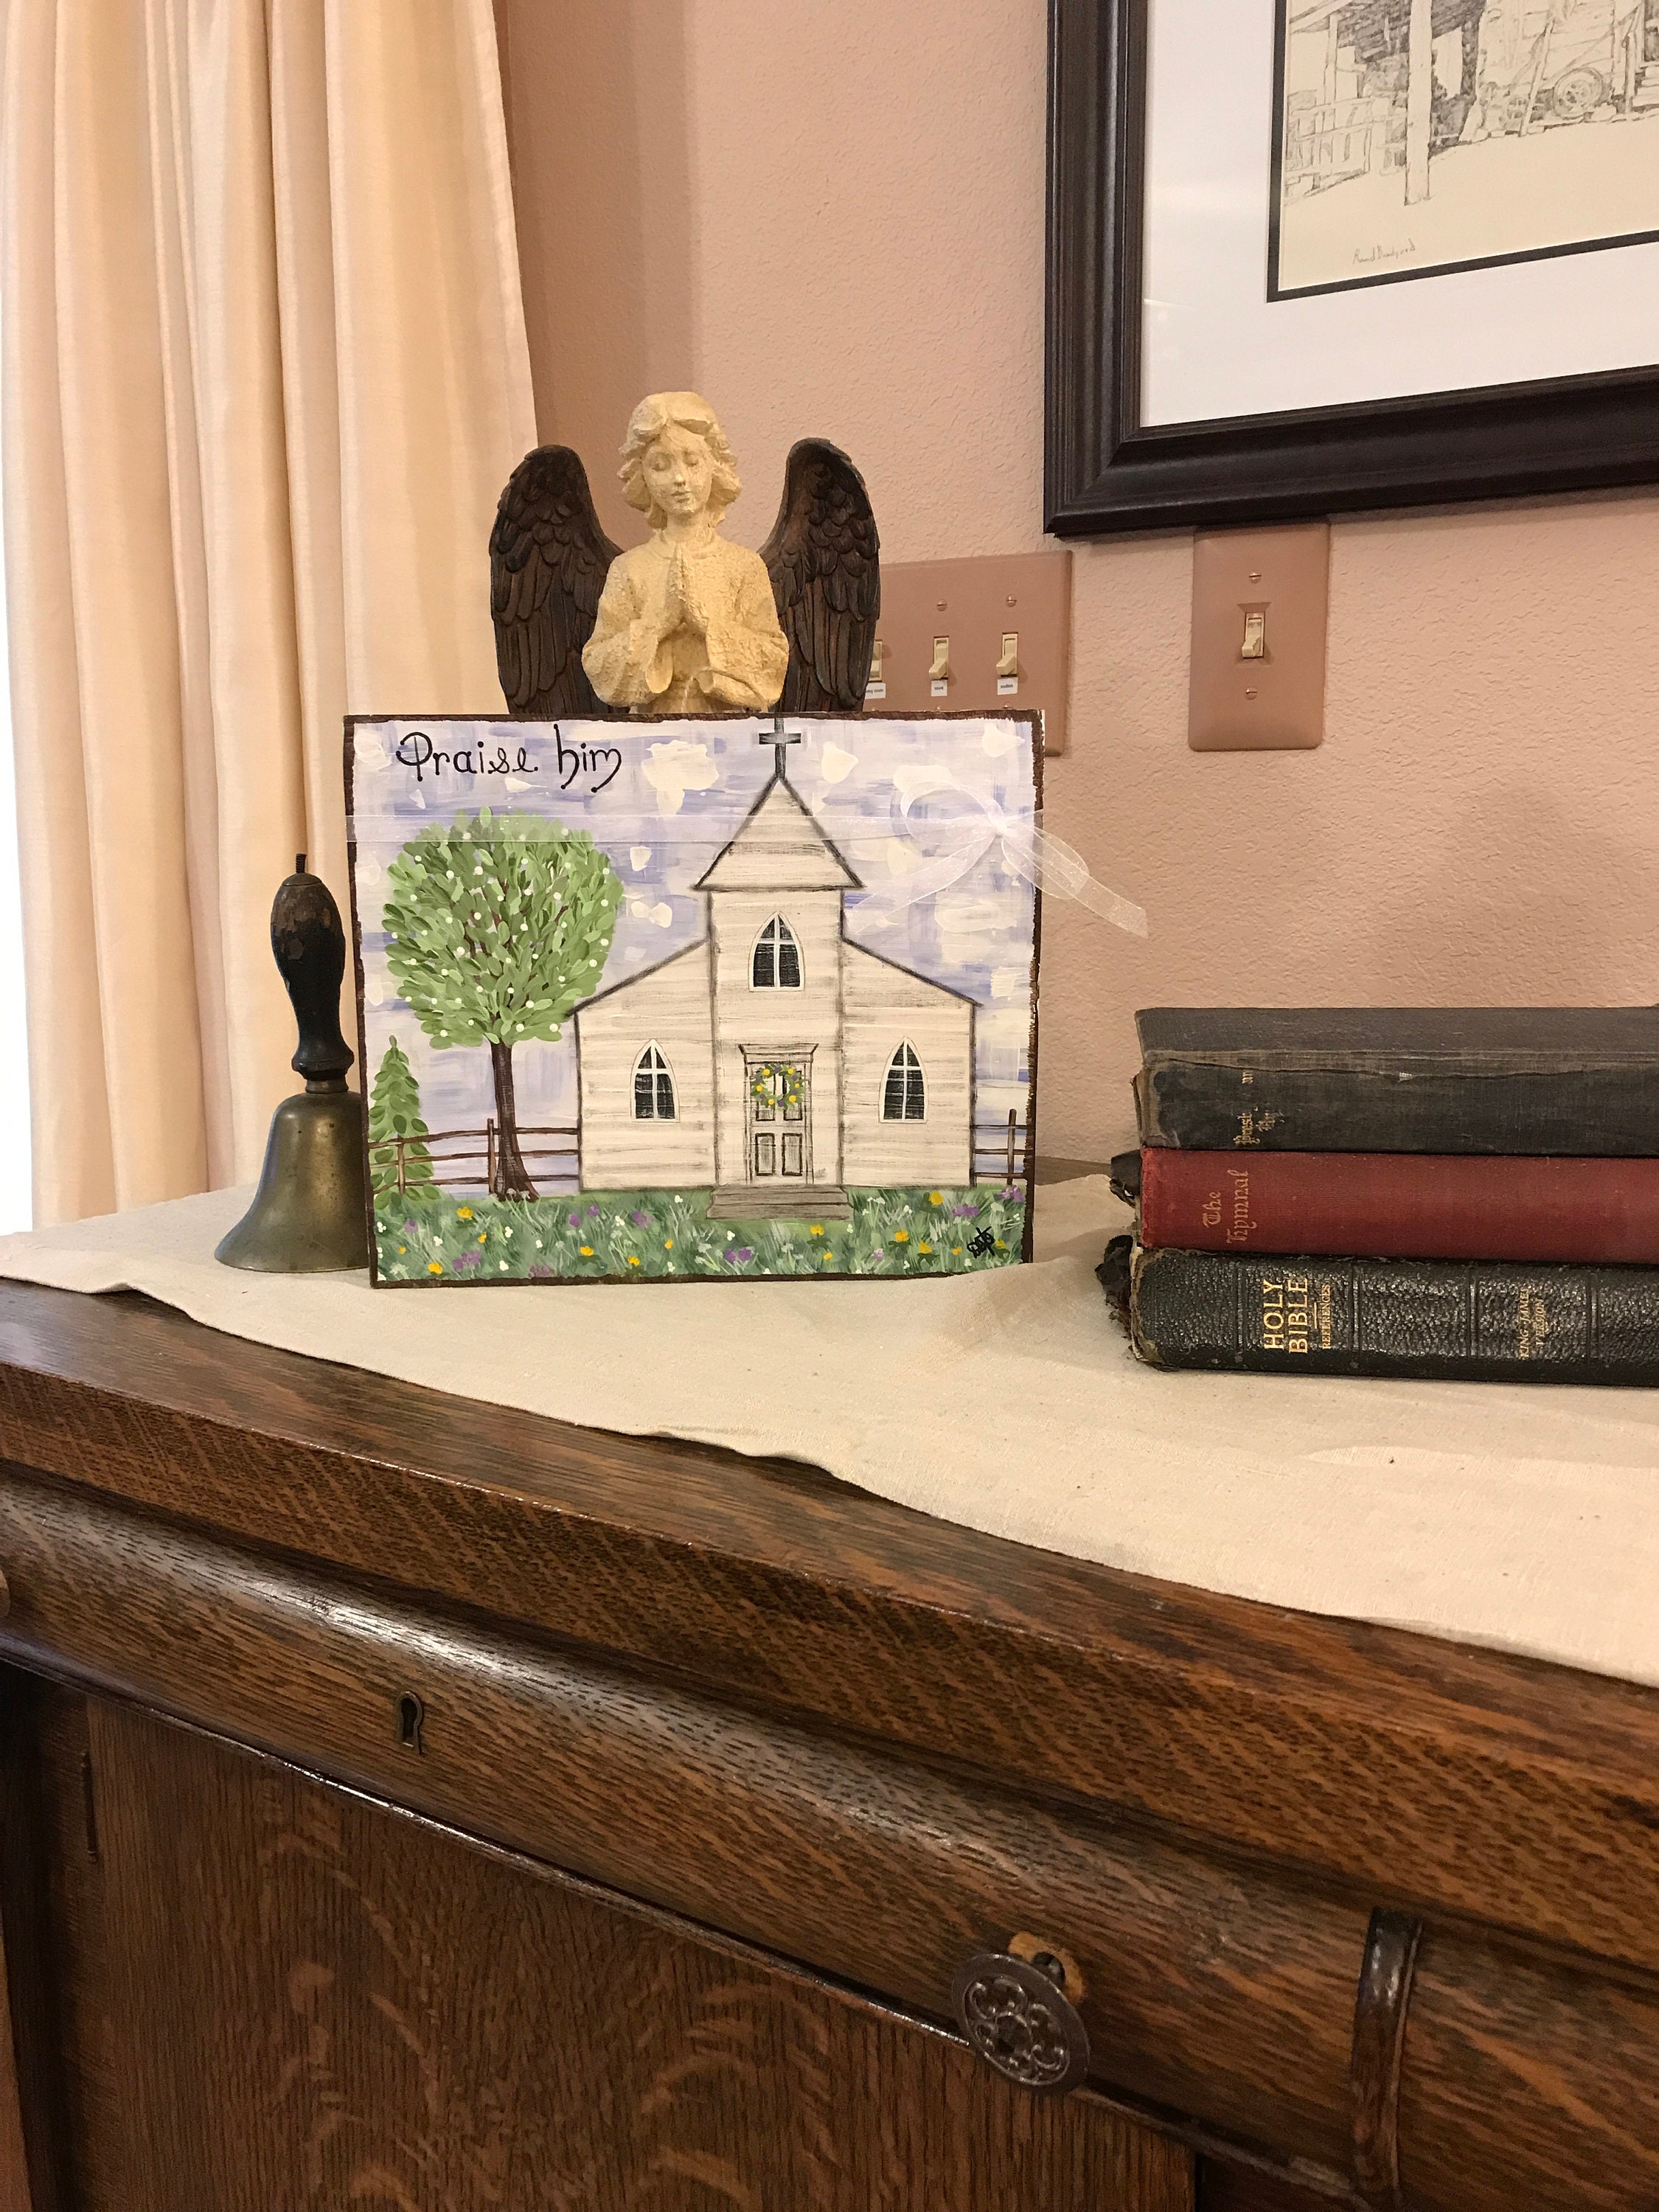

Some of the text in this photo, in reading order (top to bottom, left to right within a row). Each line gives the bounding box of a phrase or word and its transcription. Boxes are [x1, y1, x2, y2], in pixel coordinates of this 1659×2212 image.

[395, 723, 622, 793] Praise him
[1203, 1192, 1222, 1228] The
[1226, 1168, 1257, 1244] Hymnal
[1263, 1279, 1284, 1350] HOLY
[1287, 1278, 1308, 1354] BIBLE
[1322, 1284, 1332, 1350] REFERENCES
